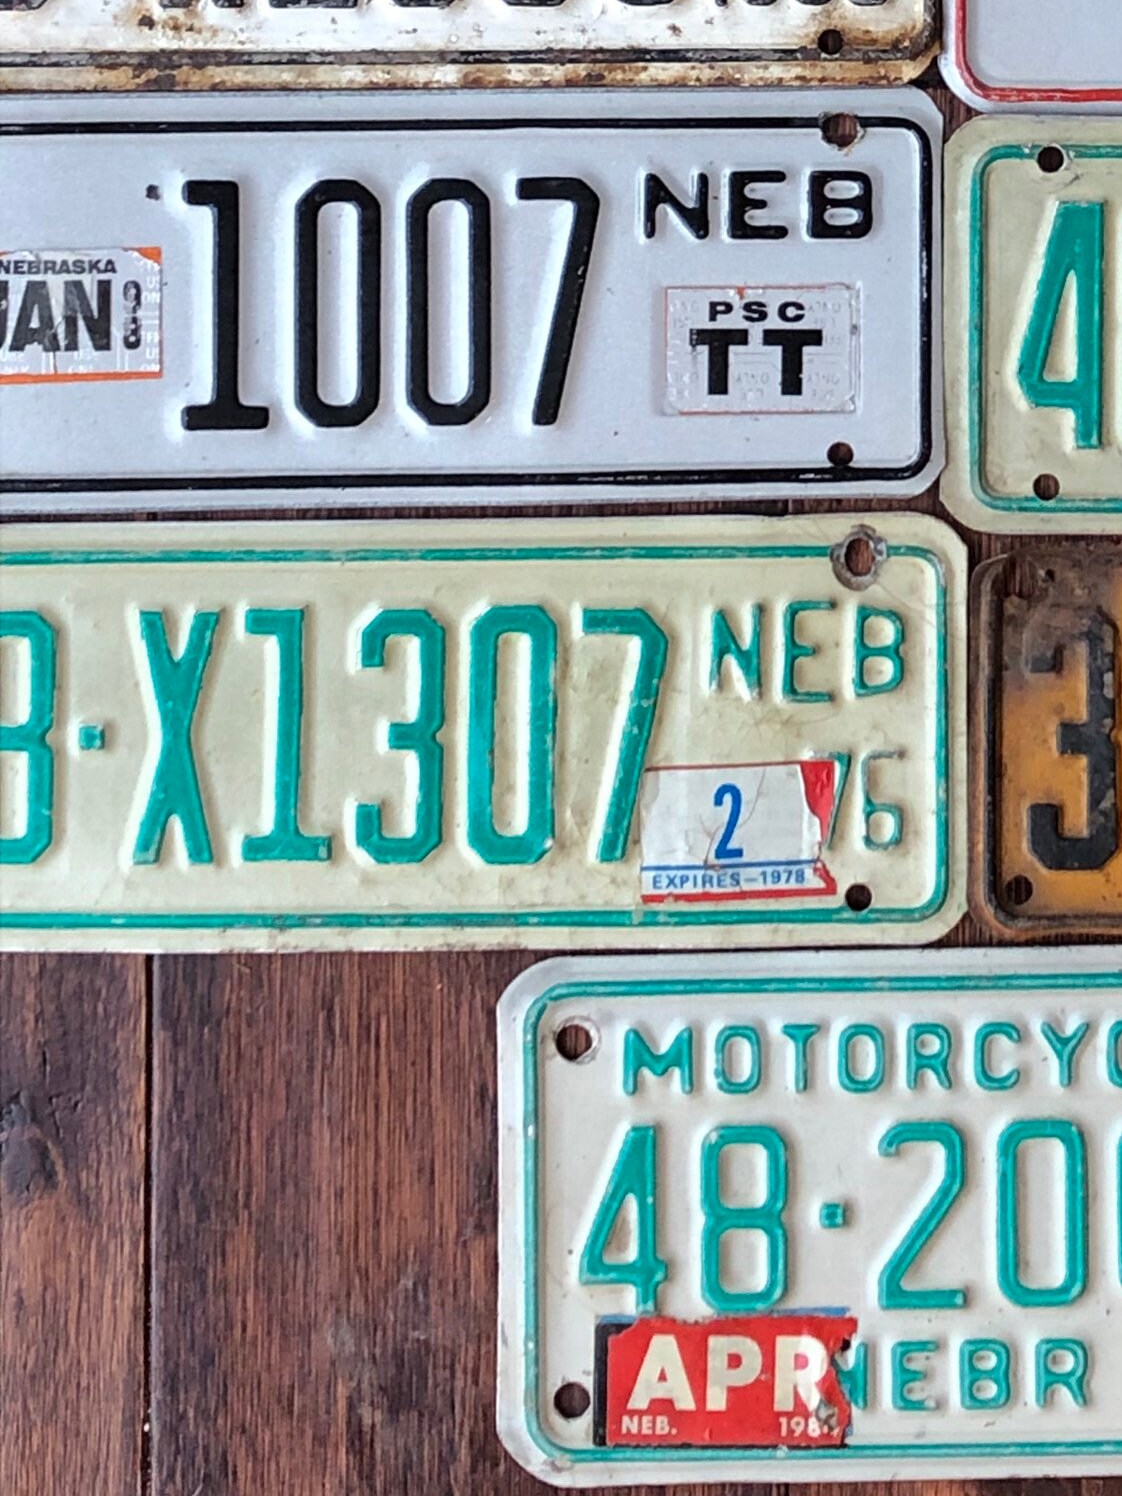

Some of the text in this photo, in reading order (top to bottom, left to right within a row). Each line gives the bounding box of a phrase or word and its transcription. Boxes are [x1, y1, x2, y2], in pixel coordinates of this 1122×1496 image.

[643, 169, 875, 241] NEB
[0, 258, 118, 275] NEBRASKA
[0, 279, 112, 353] AN
[181, 177, 601, 433] 1007
[708, 301, 806, 323] PSC
[708, 599, 906, 703] NEB
[713, 783, 744, 860] 2
[626, 1334, 828, 1413] APR
[621, 1415, 679, 1437] NEB.
